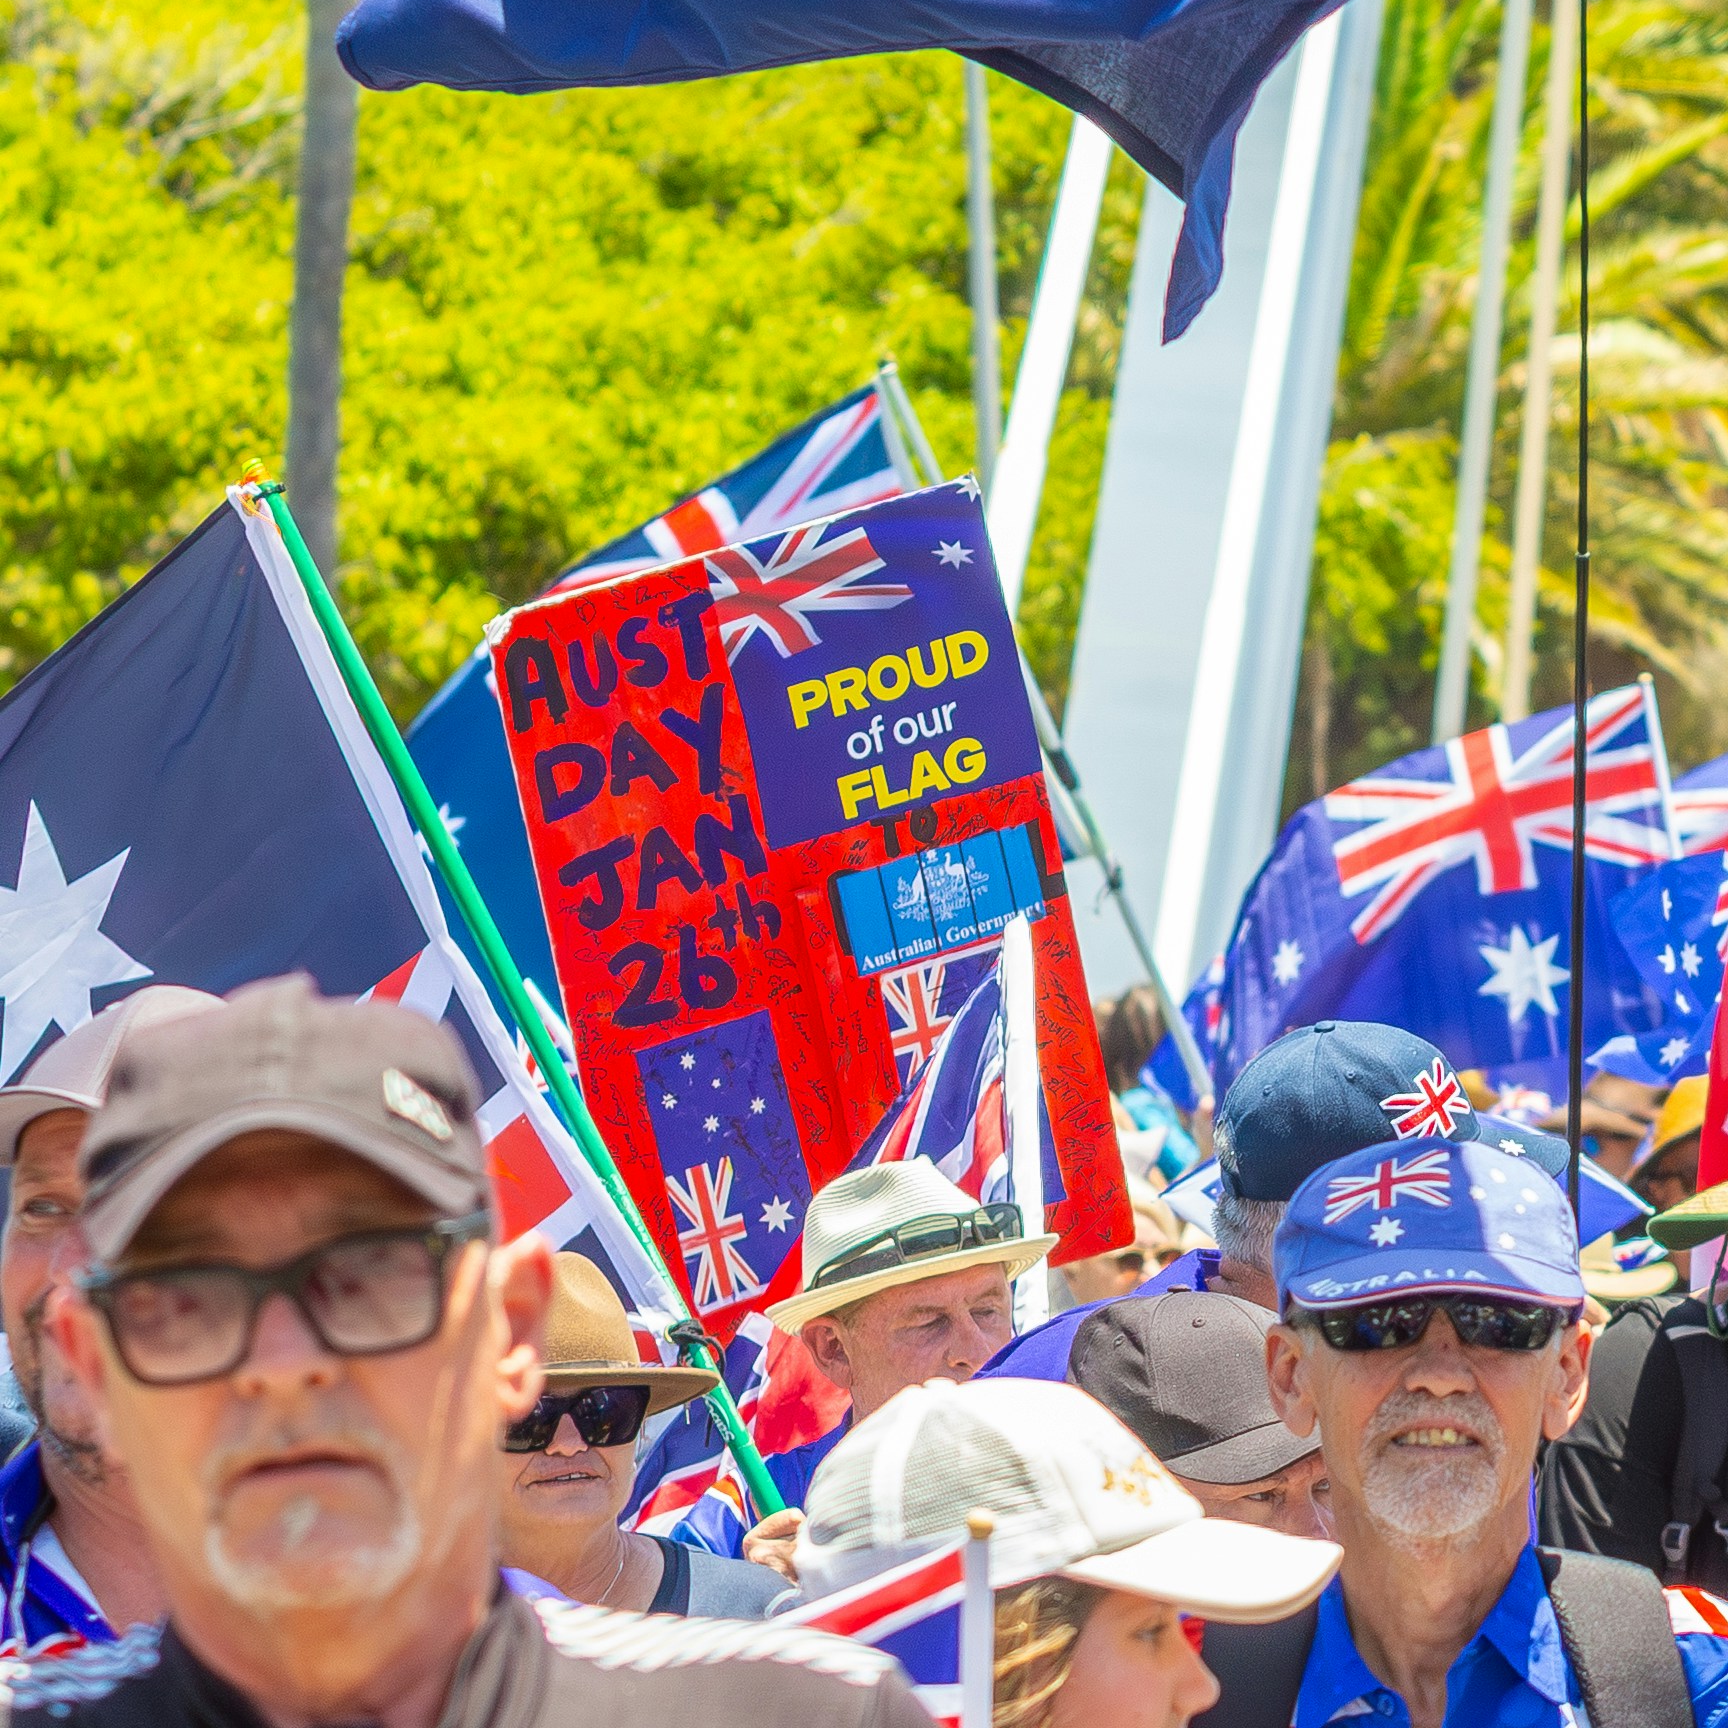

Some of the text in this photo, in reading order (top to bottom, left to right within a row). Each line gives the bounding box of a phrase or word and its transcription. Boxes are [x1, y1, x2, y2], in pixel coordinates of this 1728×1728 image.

[504, 588, 715, 733] AUST
[787, 630, 989, 729] PROUD
[534, 682, 725, 824] DAY
[846, 701, 957, 760] of our
[836, 737, 987, 820] FLAG
[558, 793, 769, 931] JAN
[869, 806, 939, 859] TO
[862, 901, 1041, 972] Australian Governmnt
